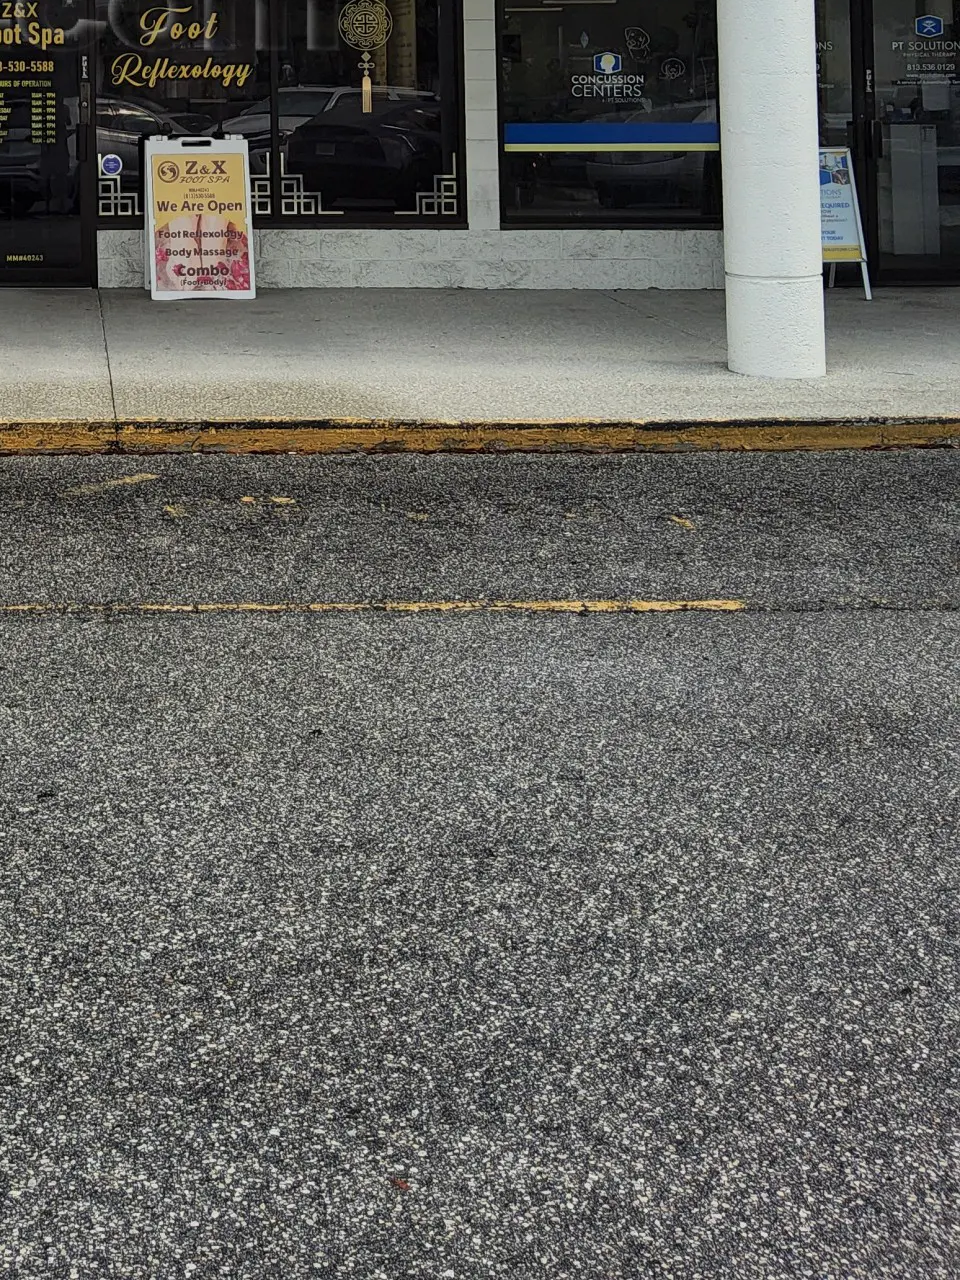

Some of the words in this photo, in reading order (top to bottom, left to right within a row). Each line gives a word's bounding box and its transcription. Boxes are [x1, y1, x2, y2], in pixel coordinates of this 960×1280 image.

[2, 2, 38, 18] Z&X
[140, 6, 218, 46] Foot
[28, 21, 65, 50] Spa
[891, 41, 904, 51] PT
[111, 52, 253, 88] Reflexology
[571, 75, 645, 84] CONCUSSION
[571, 84, 642, 97] CENTERS
[185, 160, 227, 175] Z&X
[208, 175, 230, 183] SPA
[157, 200, 178, 212] We
[181, 200, 204, 212] Are
[207, 200, 243, 214] Open
[159, 230, 181, 238] Foot
[183, 229, 244, 240] Reflexology
[165, 248, 192, 258] Body
[193, 248, 239, 258] Massage
[178, 265, 230, 277] Combo
